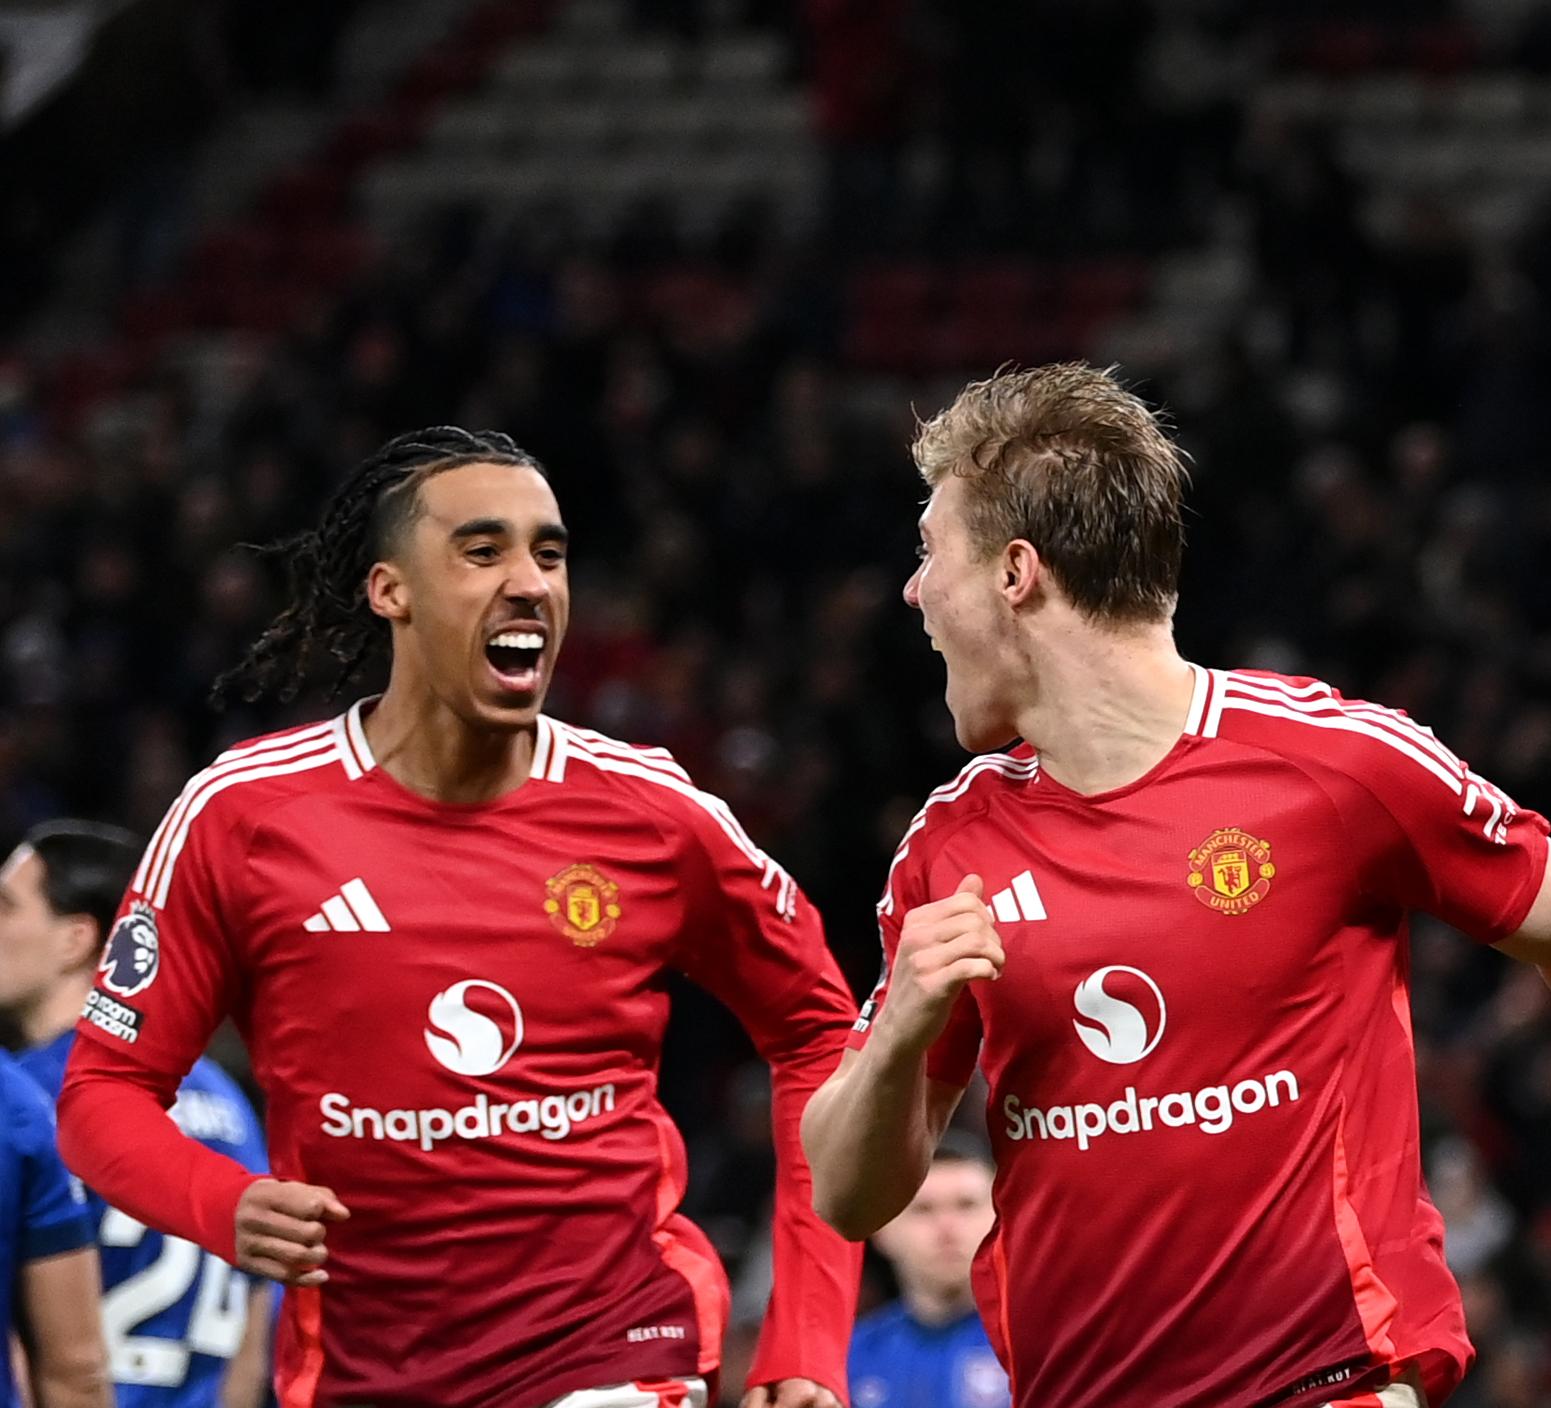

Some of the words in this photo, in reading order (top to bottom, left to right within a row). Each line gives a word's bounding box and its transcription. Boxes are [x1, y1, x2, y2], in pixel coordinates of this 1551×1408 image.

[1194, 834, 1265, 866] MANCHESTER
[1210, 891, 1259, 909] UNITED
[320, 1084, 615, 1151] Snapdragon
[1004, 1070, 1299, 1151] Snapdragon
